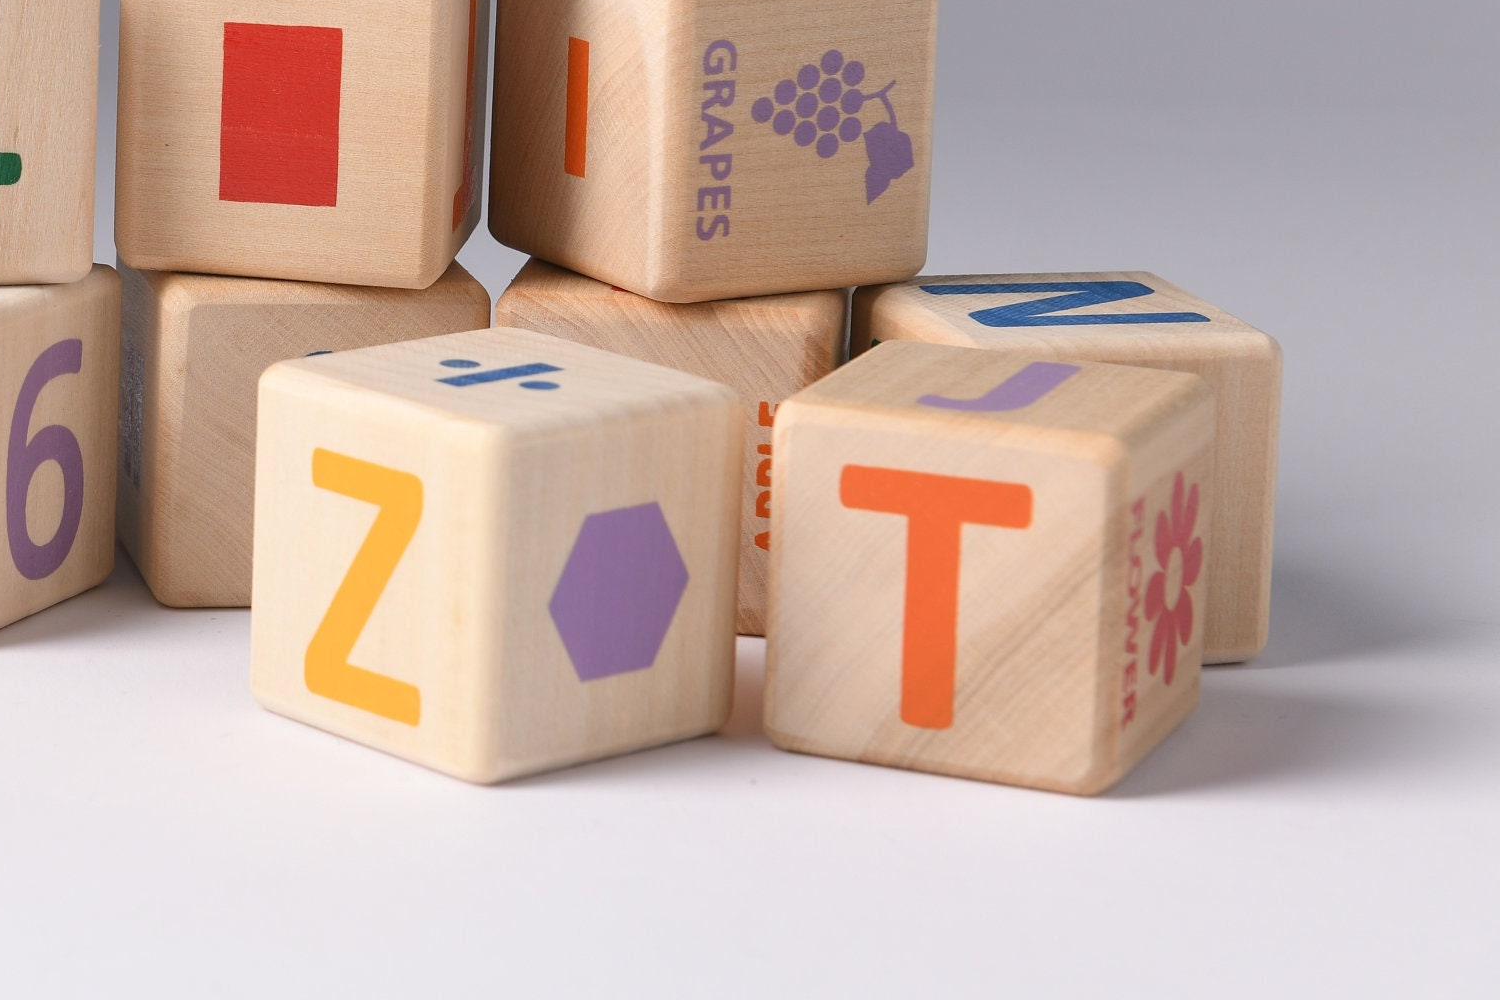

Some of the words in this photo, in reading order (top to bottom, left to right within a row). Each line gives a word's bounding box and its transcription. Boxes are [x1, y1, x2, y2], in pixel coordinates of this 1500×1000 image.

[696, 39, 738, 242] GRAPES
[6, 338, 84, 581] 6
[916, 361, 1082, 412] J
[304, 447, 424, 728] Z
[839, 464, 1034, 730] T
[1121, 495, 1146, 730] FLOWER
